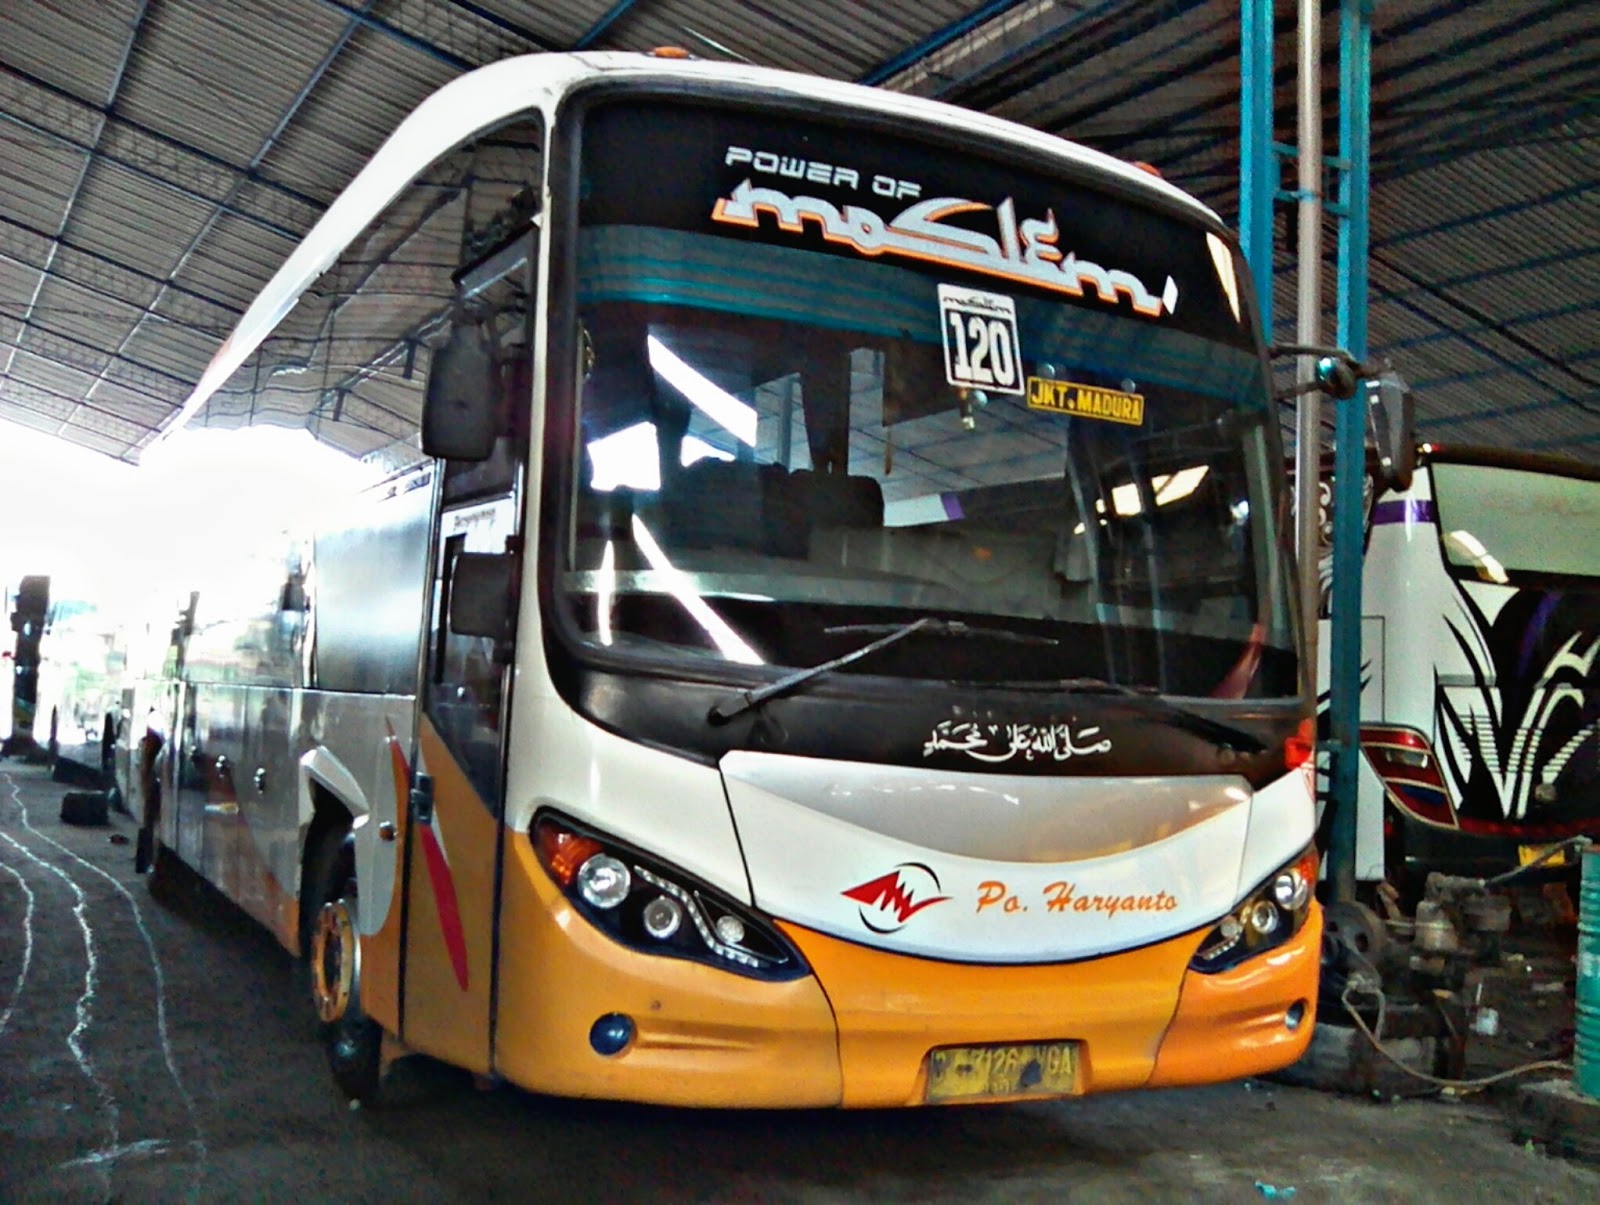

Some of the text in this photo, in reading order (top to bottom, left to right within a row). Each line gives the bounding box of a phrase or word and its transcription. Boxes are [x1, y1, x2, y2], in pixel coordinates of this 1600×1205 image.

[725, 146, 922, 200] POWER OF
[950, 312, 1015, 387] 120
[976, 880, 1178, 918] Po. Haryanto
